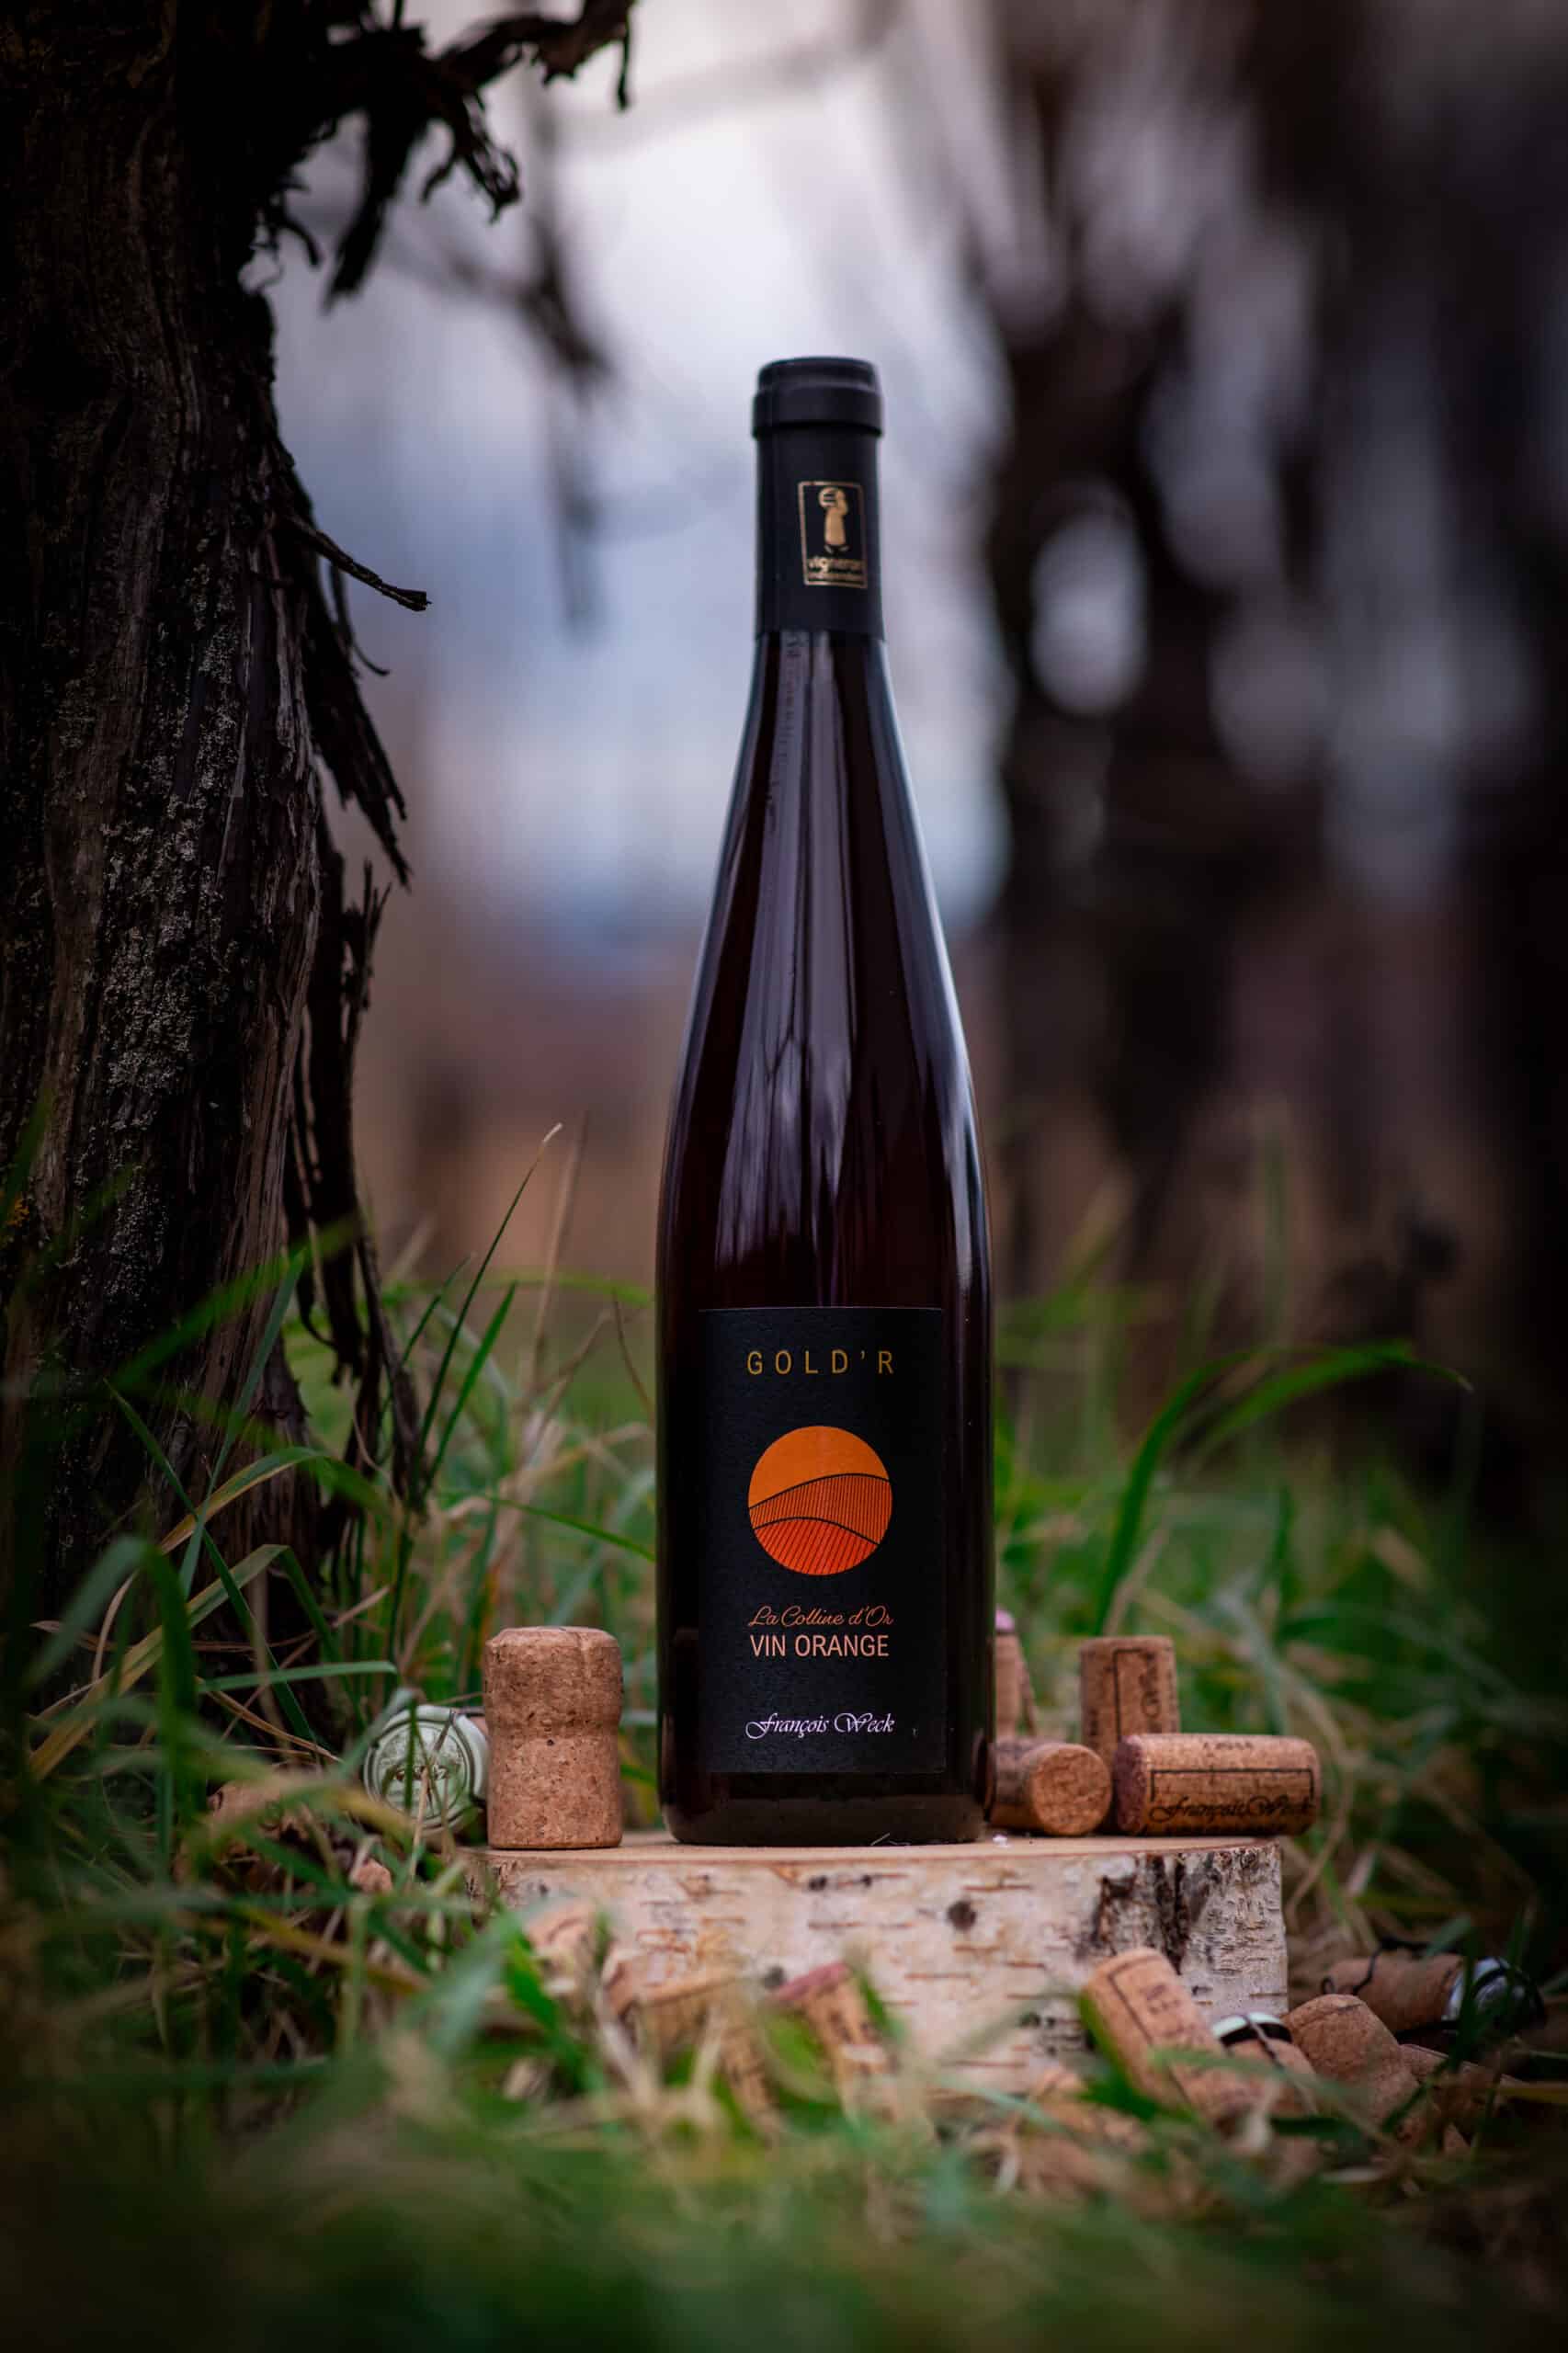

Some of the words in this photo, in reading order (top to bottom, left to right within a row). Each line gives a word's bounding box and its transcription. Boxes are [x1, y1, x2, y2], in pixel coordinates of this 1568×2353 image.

[746, 1350, 895, 1375] GOLD'R
[748, 1606, 778, 1626] La
[781, 1606, 845, 1627] Colline
[847, 1606, 894, 1627] d'Or
[750, 1634, 786, 1657] VIN
[795, 1634, 889, 1657] ORANGE
[745, 1712, 830, 1740] François
[834, 1712, 896, 1733] Weck
